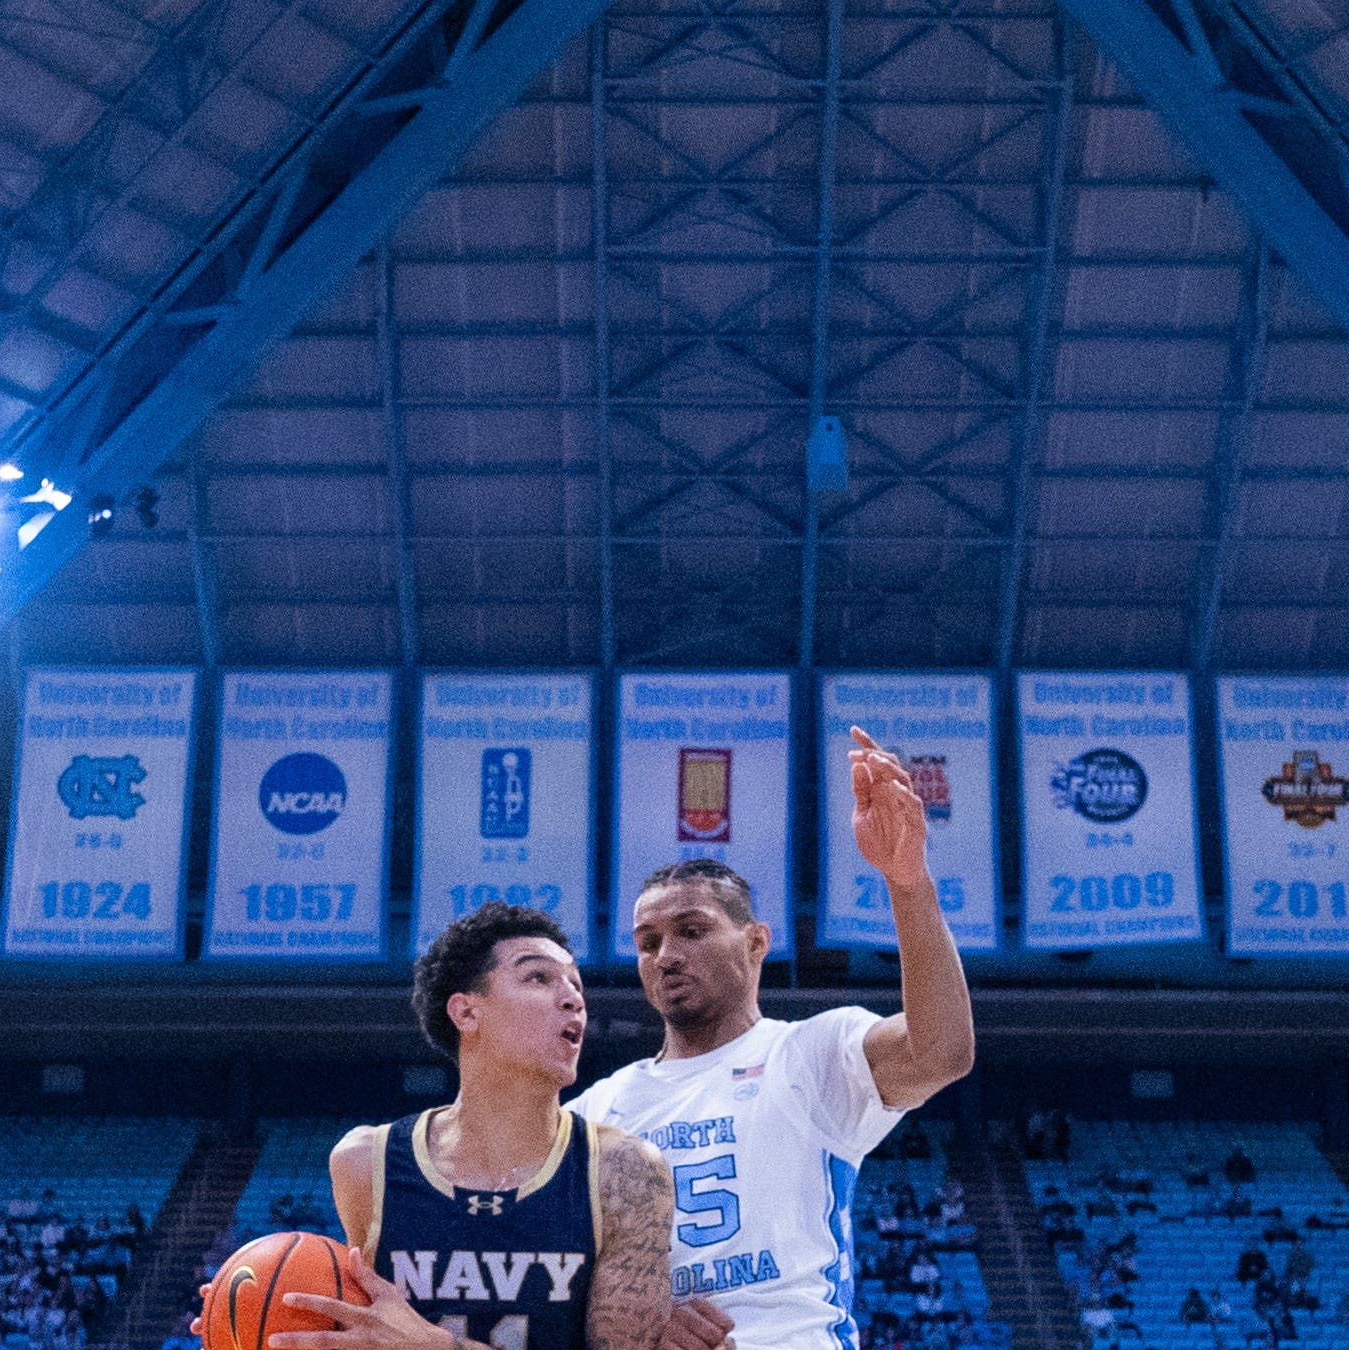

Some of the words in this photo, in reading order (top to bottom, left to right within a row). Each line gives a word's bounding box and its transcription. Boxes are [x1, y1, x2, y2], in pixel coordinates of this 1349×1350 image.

[1034, 681, 1147, 705] University
[1024, 715, 1086, 738] North
[1092, 715, 1186, 738] Carolina
[268, 791, 342, 815] NCAA
[38, 881, 152, 920] 1924
[240, 883, 358, 922] 1957
[854, 873, 965, 912] 25
[1050, 870, 1175, 913] 2009
[391, 1251, 585, 1302] NAVY
